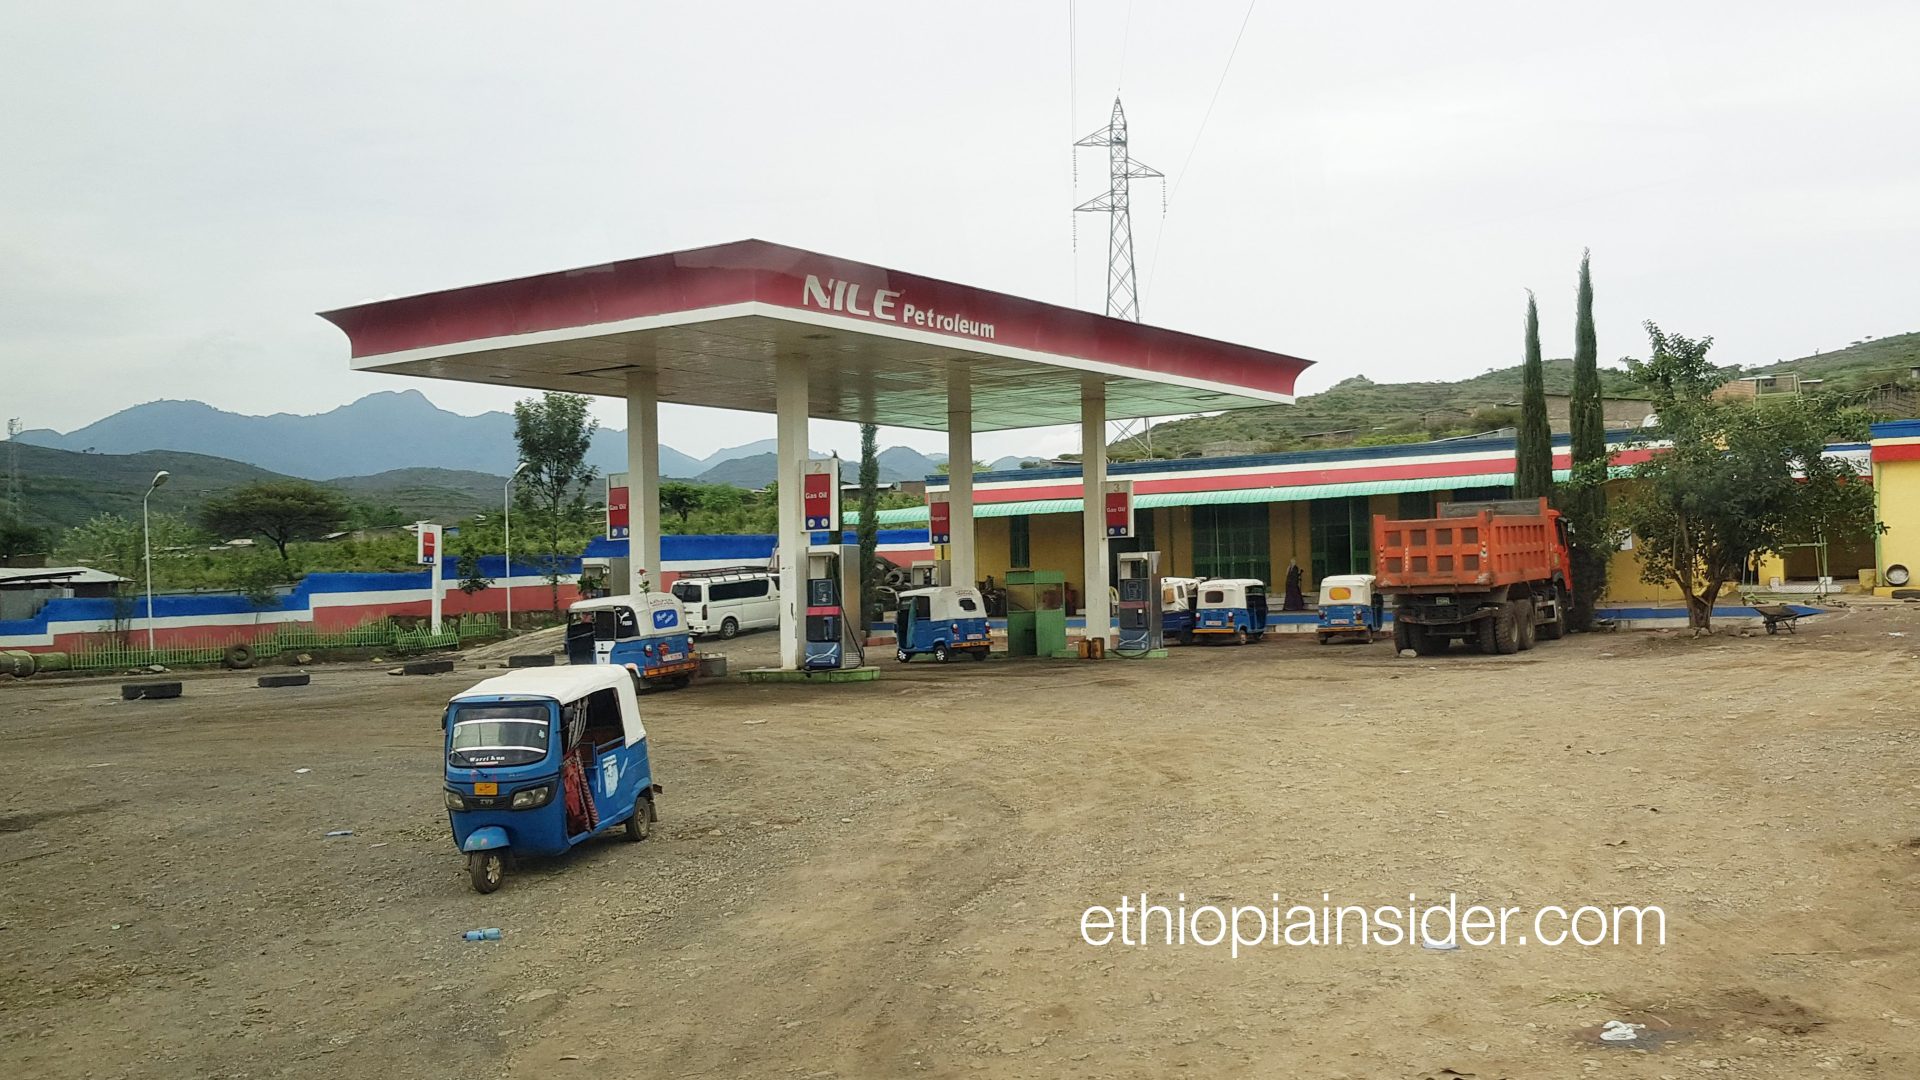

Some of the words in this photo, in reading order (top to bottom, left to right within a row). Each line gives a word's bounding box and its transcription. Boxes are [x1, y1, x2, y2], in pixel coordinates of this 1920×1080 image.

[803, 274, 900, 321] NILE
[903, 303, 995, 339] Petroleum
[814, 462, 822, 473] 2
[1113, 483, 1120, 492] 3
[818, 491, 828, 499] Oil
